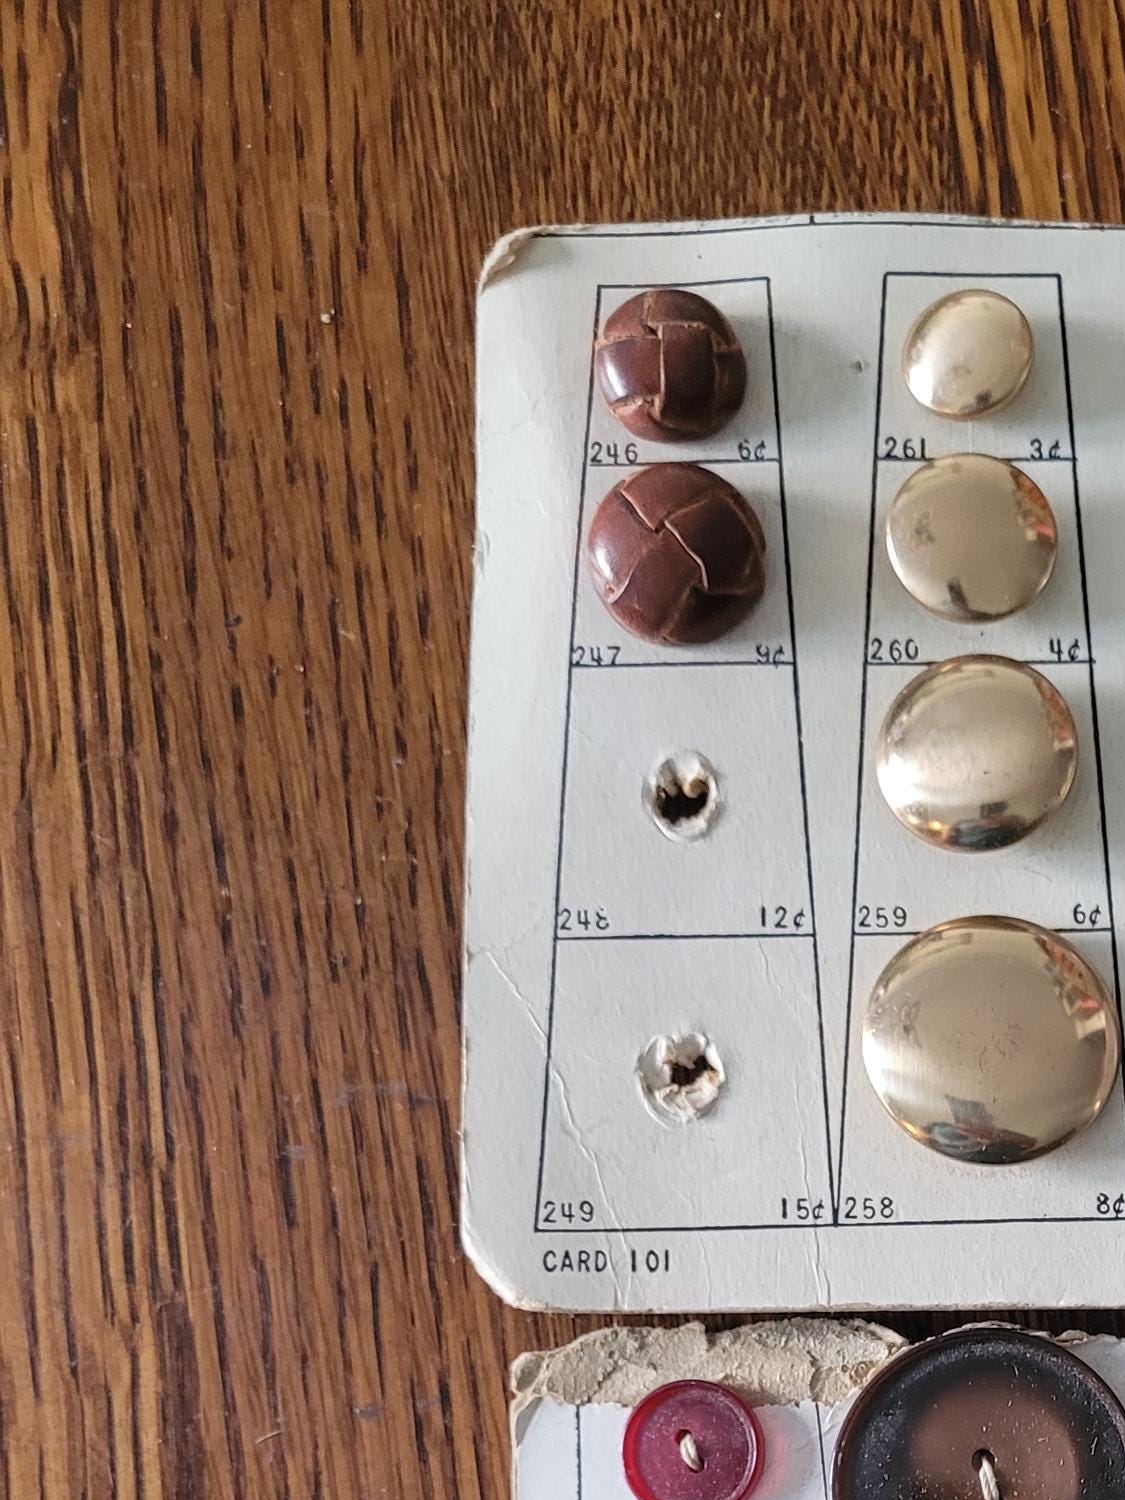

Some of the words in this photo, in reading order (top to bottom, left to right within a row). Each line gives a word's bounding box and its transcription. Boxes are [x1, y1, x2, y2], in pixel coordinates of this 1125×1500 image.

[591, 442, 638, 463] 246
[738, 441, 767, 461] 6¢
[884, 438, 930, 459] 261
[1030, 438, 1061, 459] 3¢
[572, 645, 621, 666] 247
[755, 644, 785, 665] 9¢
[871, 640, 919, 662] 260
[1049, 640, 1081, 663] 4¢
[760, 906, 807, 930] 12¢
[859, 906, 906, 927] 259
[1073, 903, 1101, 925] 6¢
[543, 1202, 594, 1223] 249
[781, 1198, 824, 1221] 15¢
[845, 1197, 894, 1219] 258
[1096, 1193, 1124, 1216] 8¢
[543, 1250, 608, 1272] CARD
[630, 1250, 670, 1272] 101
